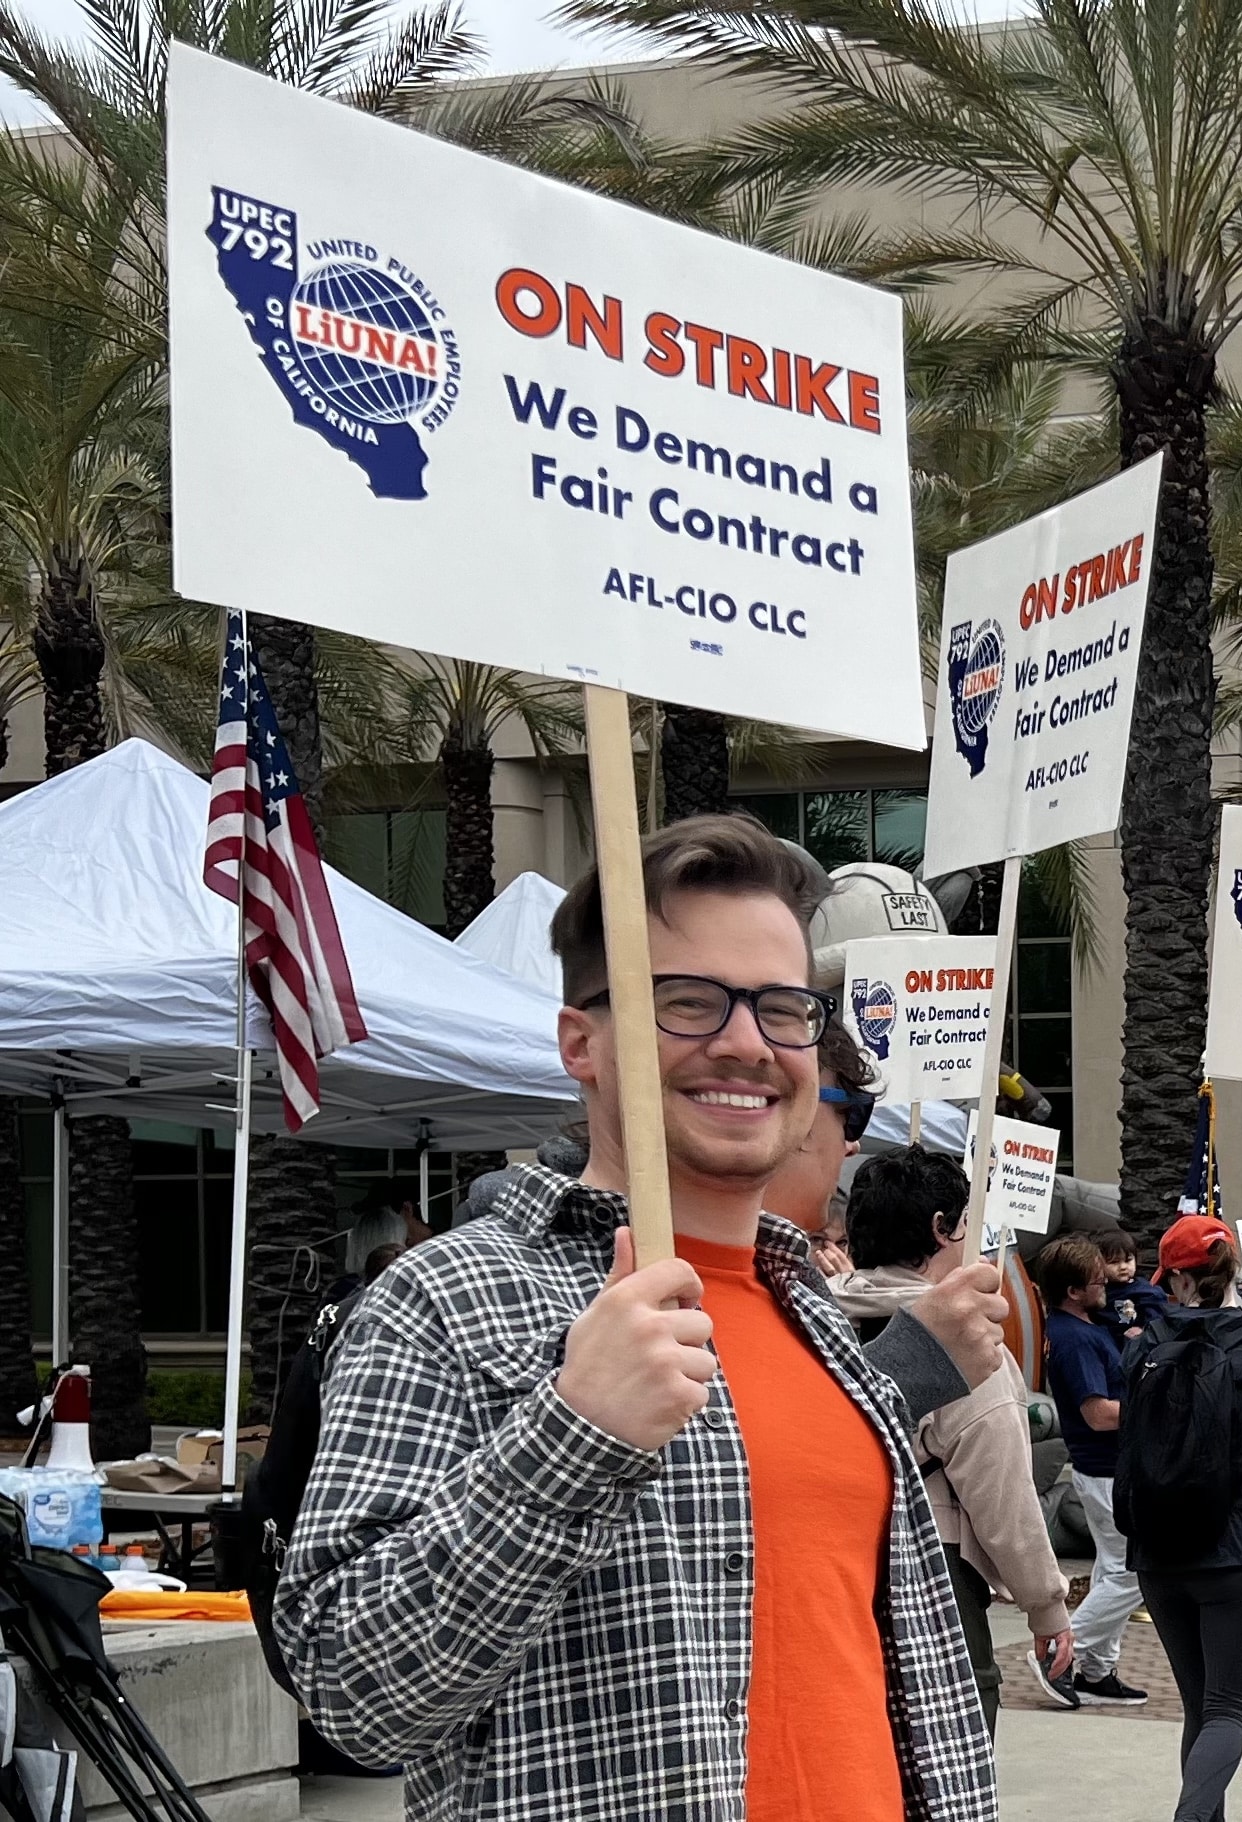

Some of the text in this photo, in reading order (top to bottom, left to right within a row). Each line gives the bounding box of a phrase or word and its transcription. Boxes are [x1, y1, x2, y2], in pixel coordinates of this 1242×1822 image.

[219, 193, 291, 236] UPEC
[220, 220, 294, 271] 792
[296, 305, 438, 378] LiUNA!
[307, 238, 462, 433] UNITED PUBLIC EMPLOYEES
[495, 267, 881, 435] ON STRIKE
[266, 297, 379, 446] OF CALIFORNIA
[504, 374, 879, 515] We Demand a
[531, 453, 864, 575] Fair Contract
[603, 567, 807, 639] AFL-CIO CLC
[1019, 533, 1144, 631] ON STRIKE
[951, 643, 969, 665] 792
[1015, 620, 1130, 692] We Demand a
[1014, 677, 1118, 741] Fair Contract
[1025, 751, 1089, 792] AFL-CIO CLC
[890, 896, 929, 910] SAFETY
[901, 911, 928, 927] LAST
[905, 970, 933, 993] ON
[936, 968, 994, 992] STRIKE
[905, 1007, 926, 1023] We
[928, 1003, 980, 1021] Demand
[909, 1028, 987, 1046] Fair Contract
[923, 1058, 972, 1072] AFL-CIO CLC
[1002, 1162, 1014, 1175] We
[1015, 1165, 1045, 1181] Demand
[1004, 1140, 1054, 1164] ON STRIKE
[1002, 1178, 1016, 1191] Fair
